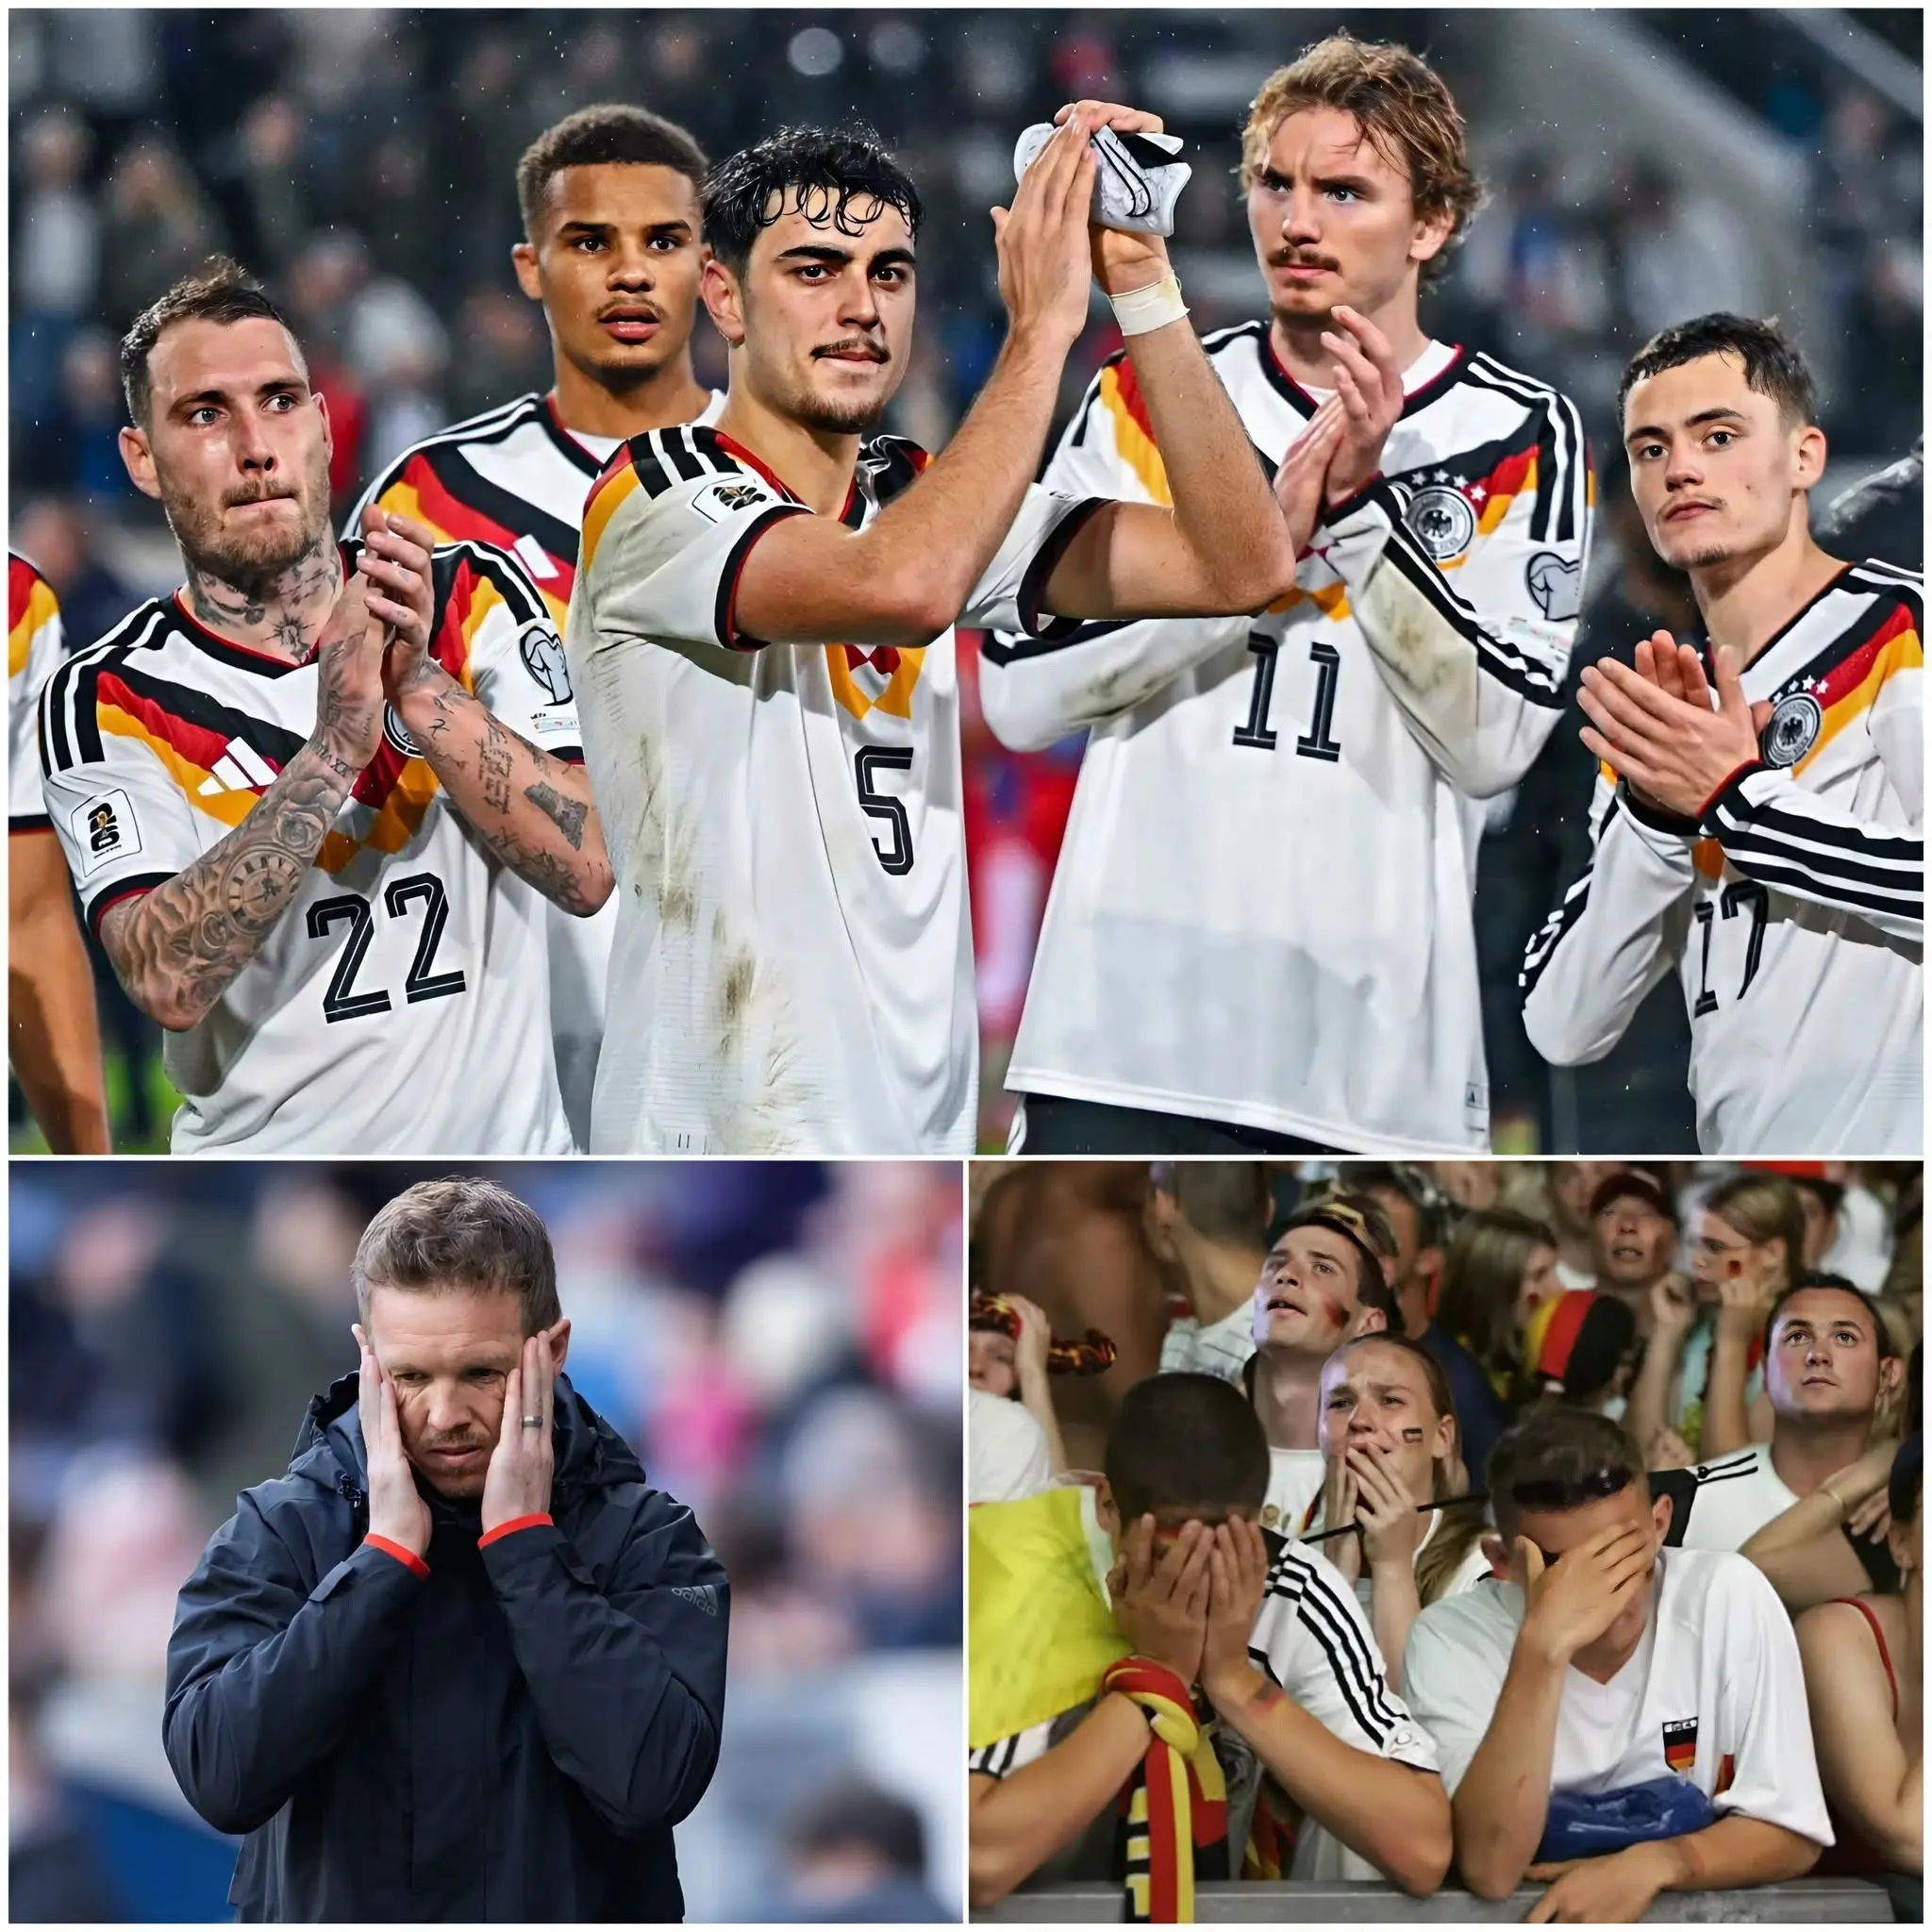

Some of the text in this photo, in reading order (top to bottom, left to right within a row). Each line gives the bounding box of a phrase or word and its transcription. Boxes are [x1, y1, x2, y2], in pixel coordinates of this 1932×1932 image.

[1233, 631, 1341, 762] 11
[855, 745, 913, 875] 5
[307, 872, 466, 1024] 22
[1694, 879, 1769, 1019] 17
